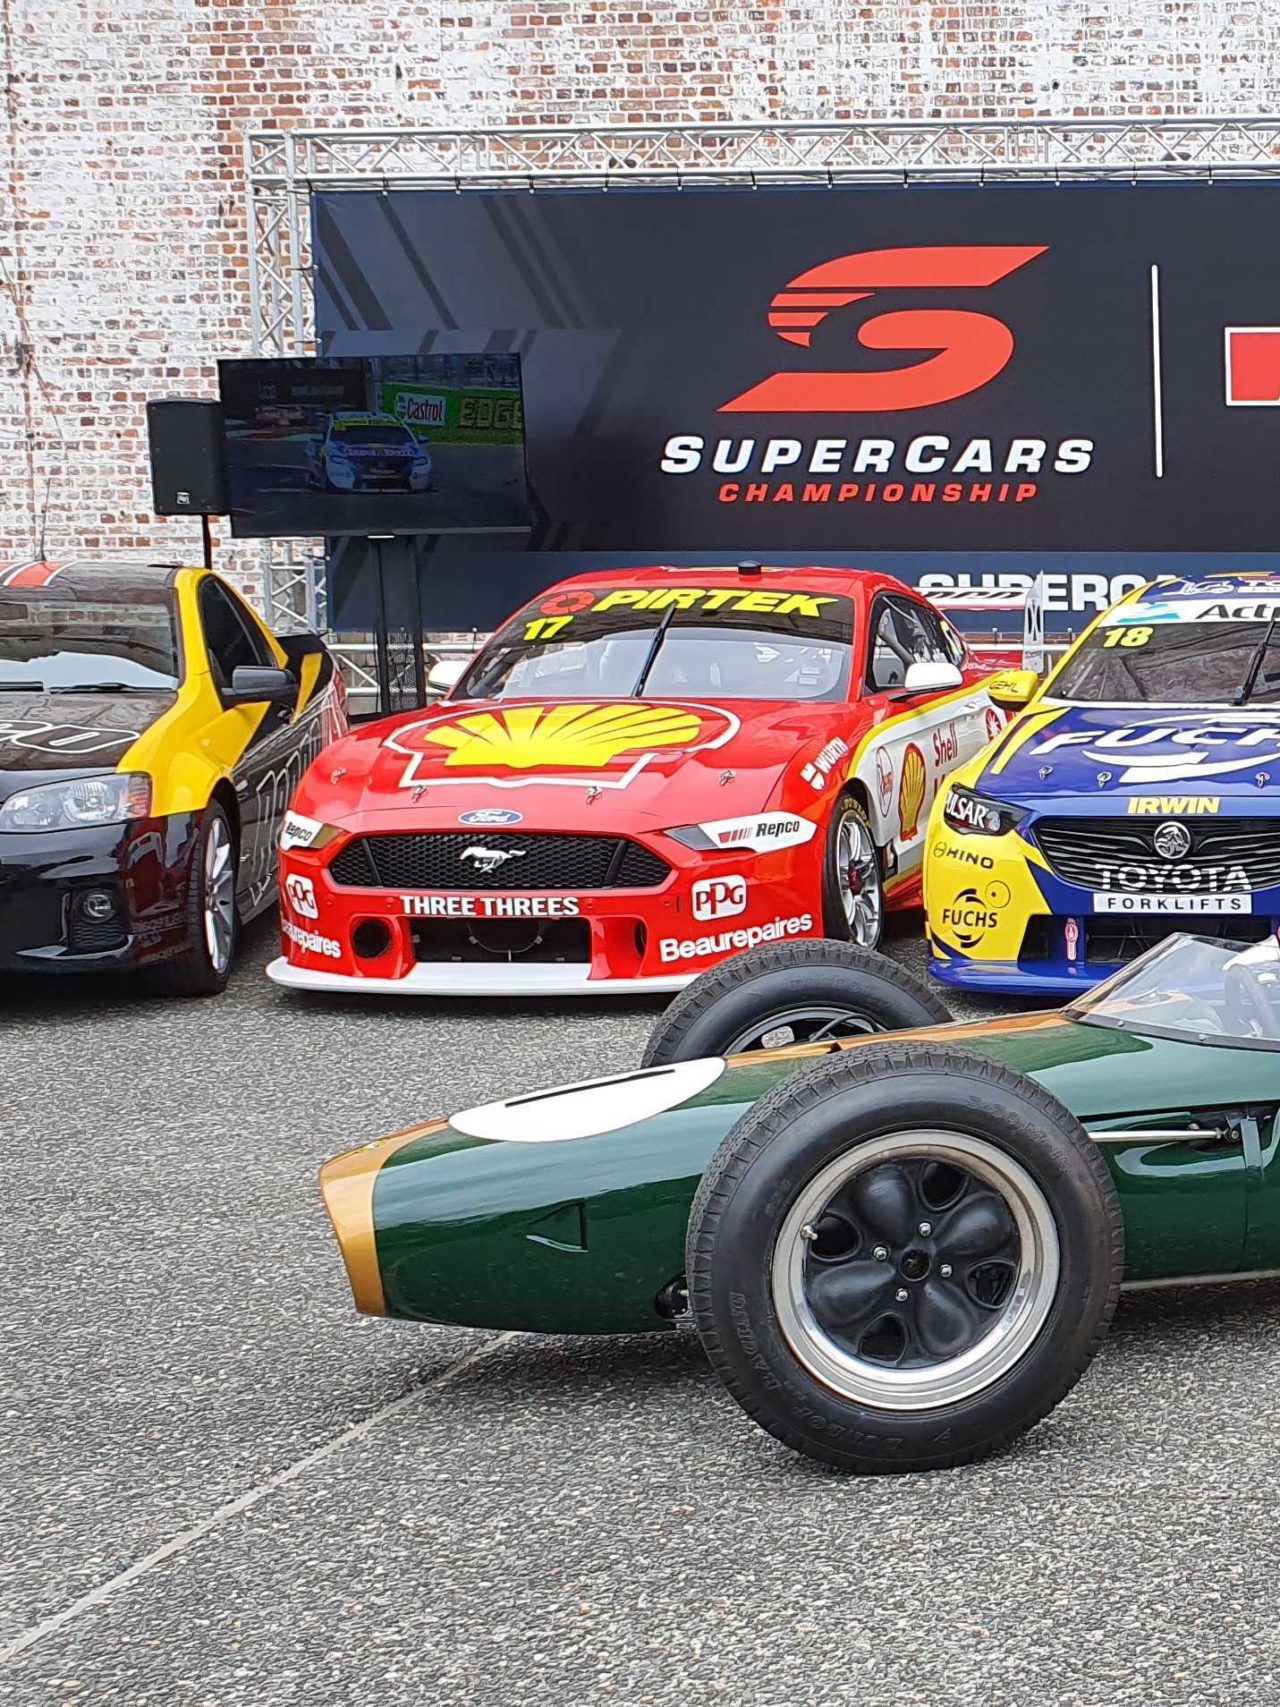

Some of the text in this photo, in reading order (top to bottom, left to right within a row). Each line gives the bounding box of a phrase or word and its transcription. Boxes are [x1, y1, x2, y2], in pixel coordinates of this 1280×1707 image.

[407, 399, 443, 421] Castrol
[661, 435, 1094, 474] SUPERCARS
[718, 483, 1038, 502] CHAMPIONSHIP
[591, 588, 839, 617] PIRTEK
[523, 615, 574, 641] 17
[1103, 627, 1153, 648] 18
[933, 722, 958, 767] Shell
[466, 810, 515, 823] Ford
[946, 790, 987, 829] ULSAR
[1127, 798, 1220, 815] IRWIN
[756, 820, 800, 837] Repco
[947, 848, 994, 869] HINO
[1095, 864, 1252, 892] TOYOTA
[400, 896, 580, 916] THREE THREES
[695, 882, 744, 915] PPG
[1108, 898, 1241, 910] FORKLIFTS
[942, 909, 998, 928] FUCHS
[660, 913, 813, 963] Beaurepaires
